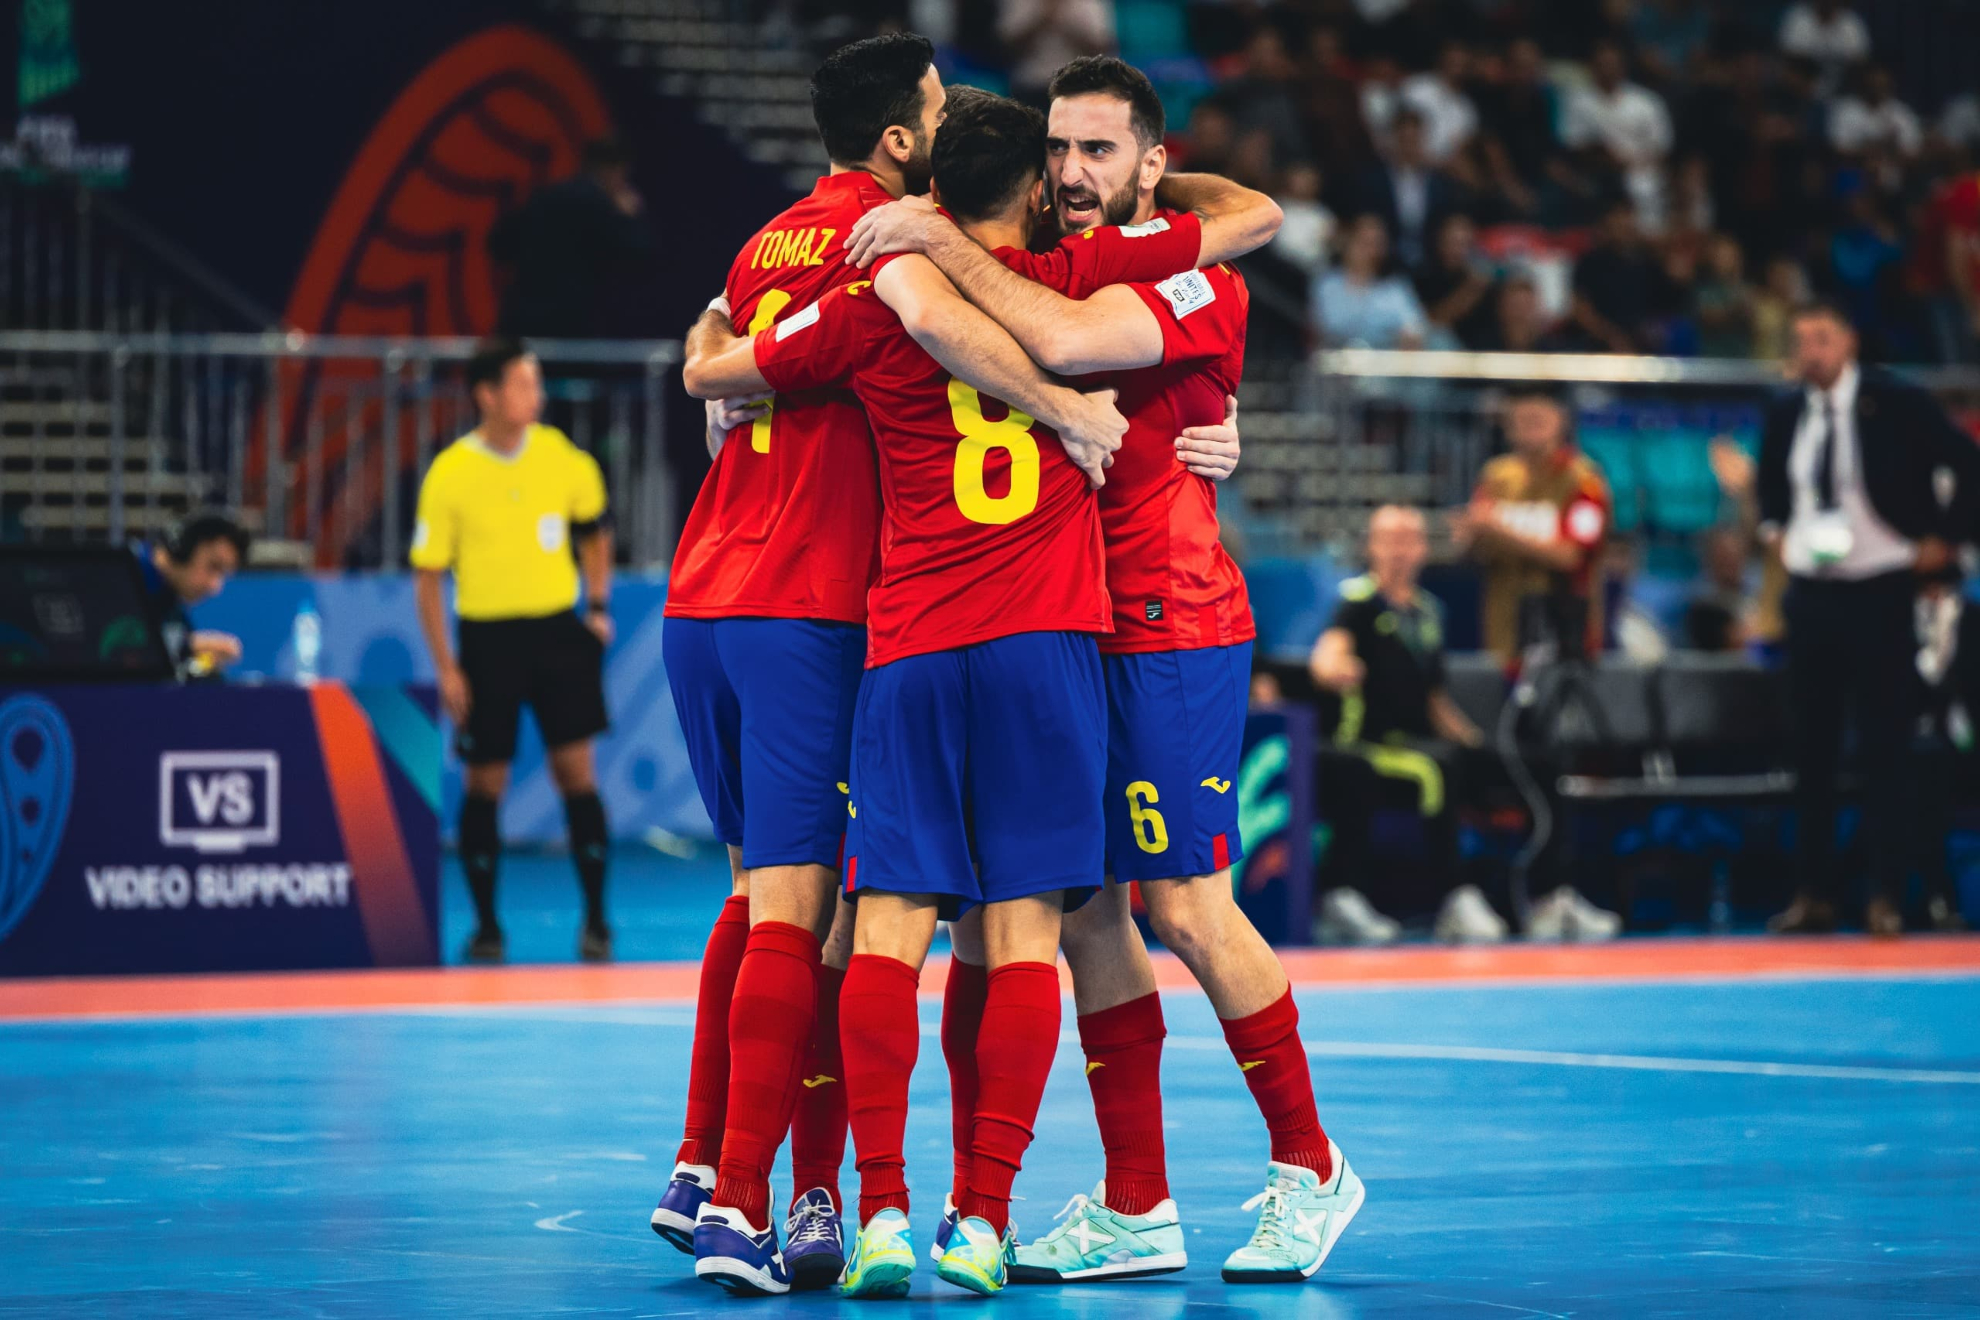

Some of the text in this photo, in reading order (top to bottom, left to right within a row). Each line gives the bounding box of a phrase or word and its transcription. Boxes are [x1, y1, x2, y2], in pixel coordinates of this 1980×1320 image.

[750, 227, 837, 270] TOMAZ
[947, 375, 1041, 525] 8
[187, 770, 254, 825] VS
[1125, 780, 1169, 855] 6
[84, 862, 352, 910] VIDEO SUPPORT
